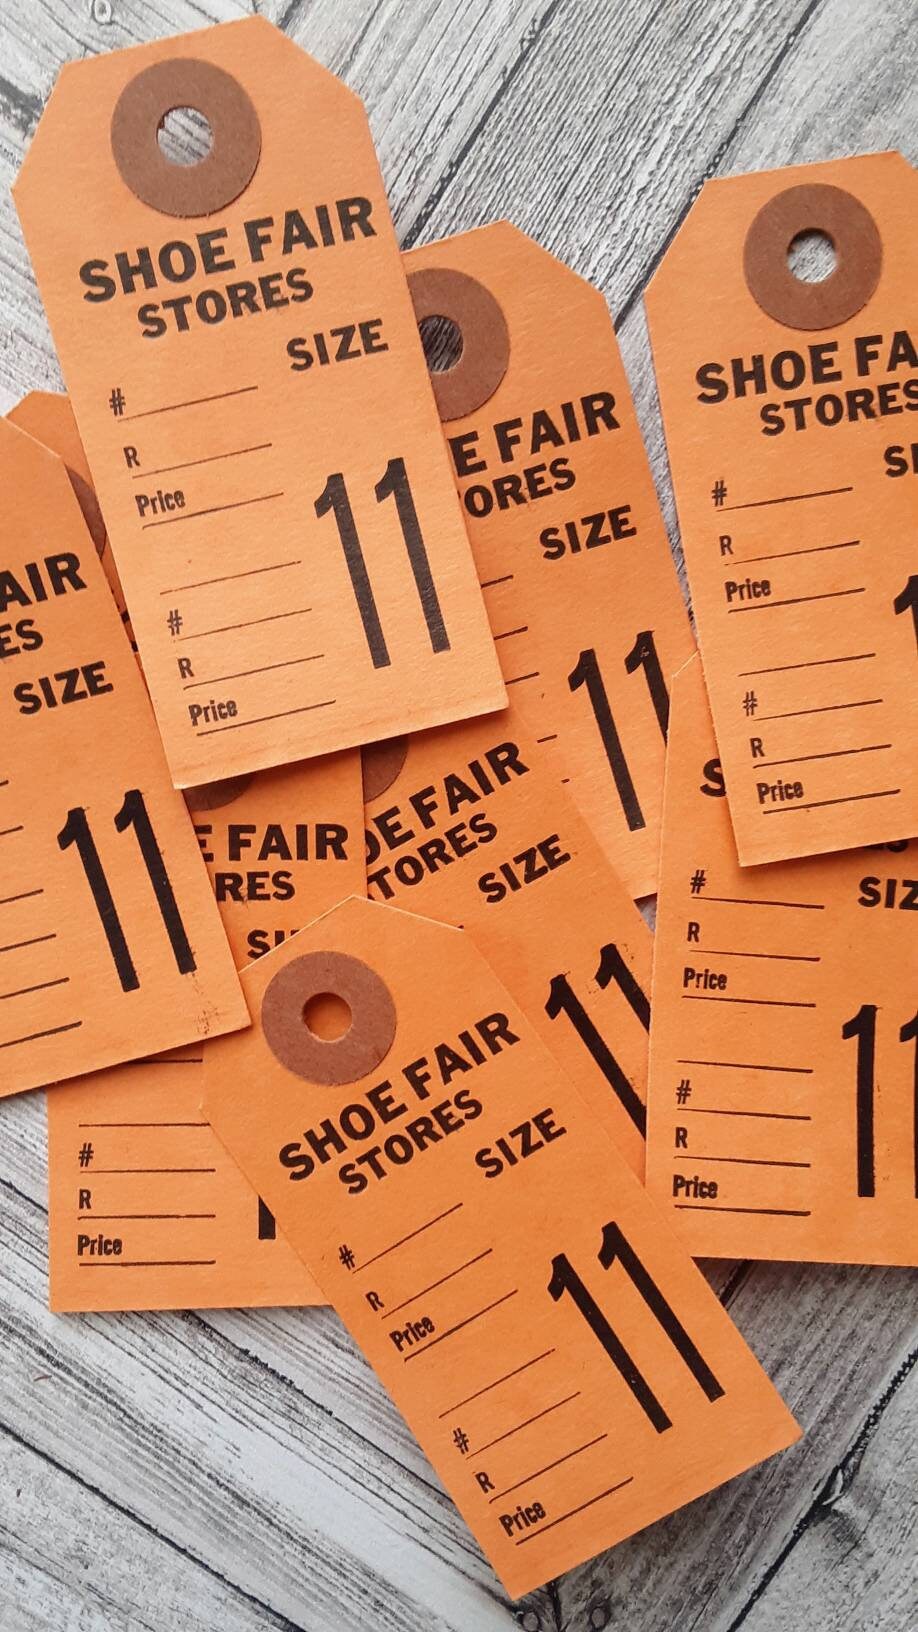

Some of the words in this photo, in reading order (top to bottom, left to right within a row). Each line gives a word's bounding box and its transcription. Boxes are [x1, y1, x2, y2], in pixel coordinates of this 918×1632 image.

[80, 229, 235, 302] SHOE
[245, 197, 376, 262] FAIR
[138, 269, 313, 338] STORES
[287, 319, 389, 371] SIZE
[695, 341, 842, 404] SHOE
[854, 330, 918, 377] FA
[109, 388, 126, 416] #
[493, 391, 621, 464] FAIR
[124, 446, 141, 469] R
[464, 457, 577, 518] ORES
[711, 478, 728, 508] #
[136, 489, 186, 517] Price
[539, 504, 637, 560] SIZE
[720, 536, 732, 556] R
[314, 457, 450, 669] 11
[0, 552, 88, 613] AIR
[725, 578, 771, 602] Price
[167, 610, 184, 636] #
[179, 657, 195, 679] R
[13, 660, 114, 715] SIZE
[188, 698, 238, 726] Price
[743, 691, 758, 717] #
[750, 739, 765, 758] R
[409, 741, 530, 830] FAIR
[756, 780, 804, 805] Price
[228, 824, 349, 861] FAIR
[366, 813, 498, 900] TORES
[478, 834, 571, 903] SIZE
[690, 870, 706, 895] #
[57, 789, 197, 993] 11
[214, 870, 295, 902] RES
[858, 876, 918, 911] SIZ
[688, 922, 701, 942] R
[684, 967, 727, 990] Price
[279, 1080, 406, 1181] SHOE
[402, 1013, 519, 1100] FAIR
[676, 1080, 691, 1104] #
[338, 1090, 483, 1194] STORES
[475, 1109, 567, 1178] SIZE
[675, 1127, 688, 1148] R
[78, 1142, 94, 1168] #
[79, 1189, 91, 1209] R
[673, 1174, 718, 1199] Price
[77, 1234, 123, 1256] Price
[339, 1245, 355, 1271] #
[366, 1292, 384, 1312] R
[389, 1317, 436, 1353] Price
[547, 1222, 725, 1434] 11
[453, 1428, 469, 1454] #
[475, 1472, 495, 1493] R
[499, 1502, 547, 1537] Price
